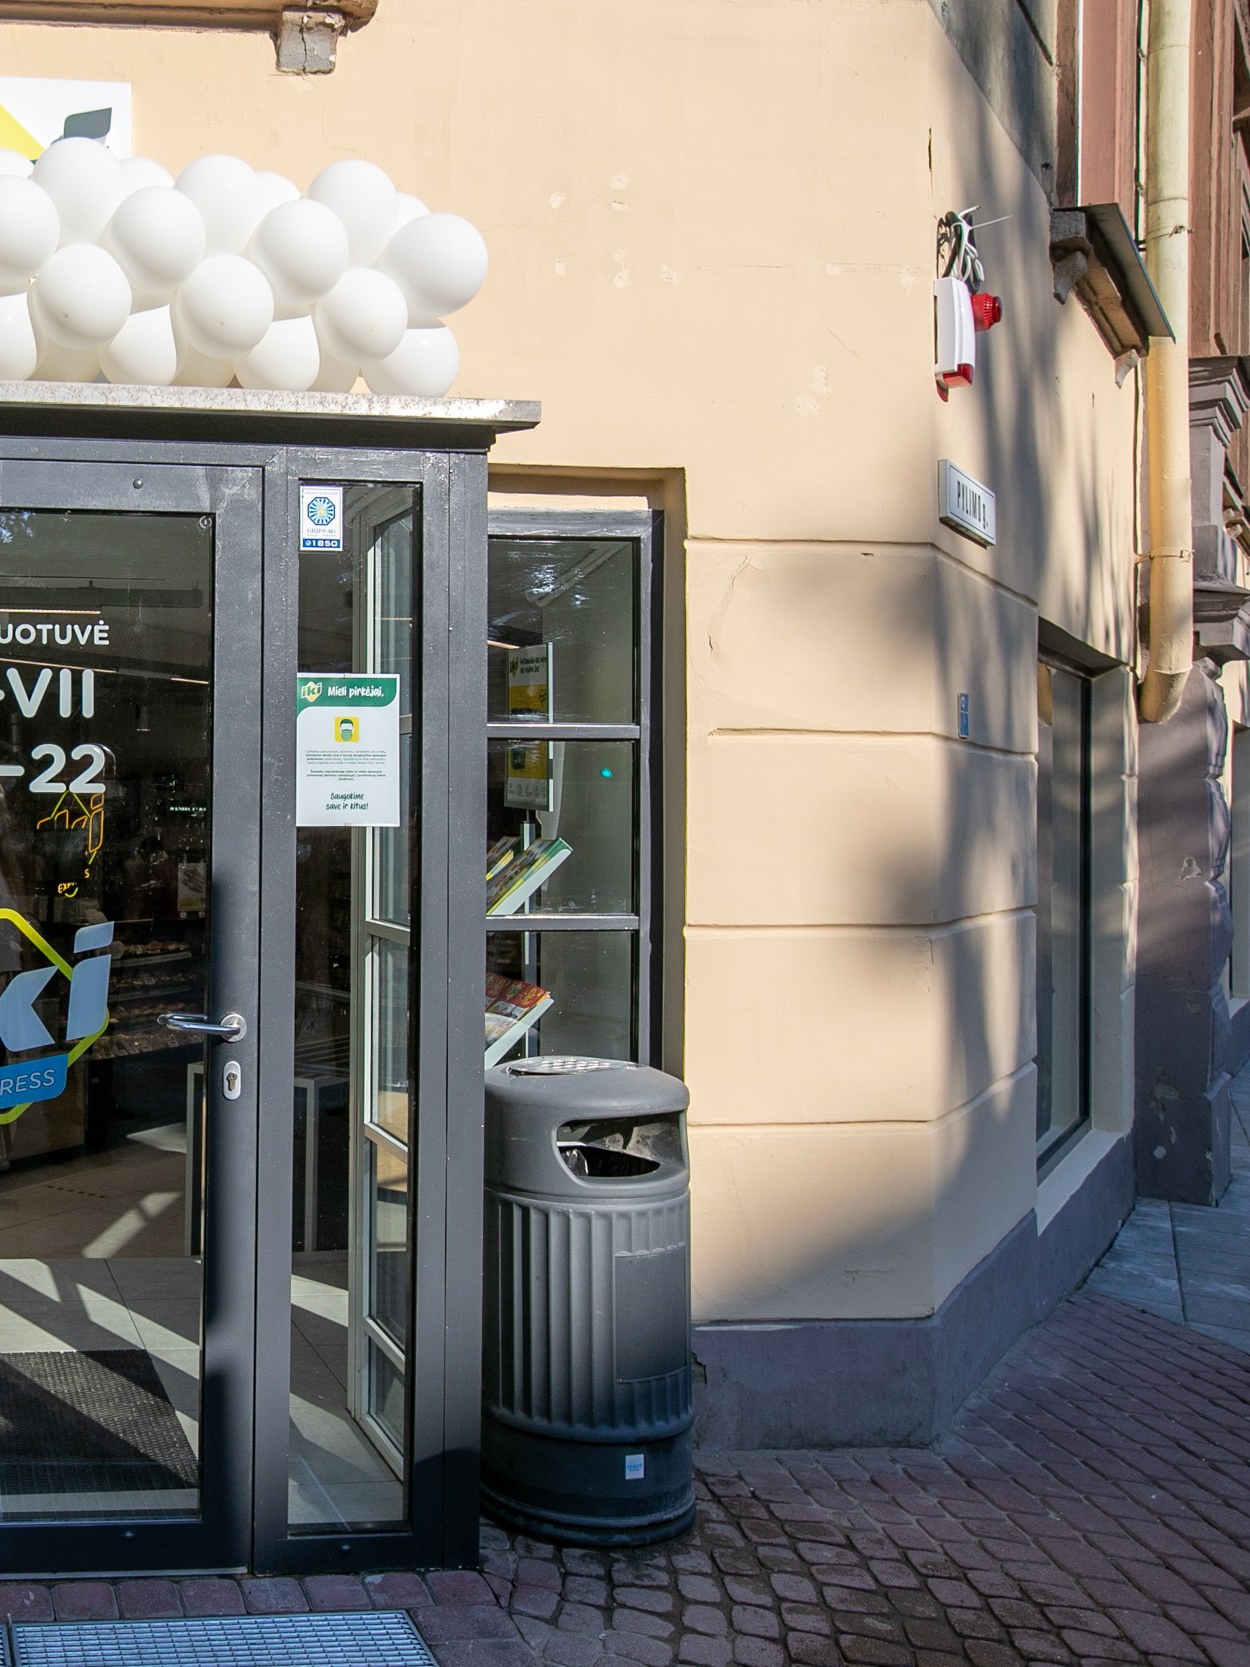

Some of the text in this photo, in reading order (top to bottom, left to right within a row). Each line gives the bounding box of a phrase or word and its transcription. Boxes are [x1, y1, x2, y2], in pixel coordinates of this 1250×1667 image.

[957, 480, 981, 522] PYLIMO
[301, 682, 323, 699] iki
[327, 685, 347, 697] Mieli
[342, 802, 349, 810] ir
[350, 802, 369, 810] kitus!
